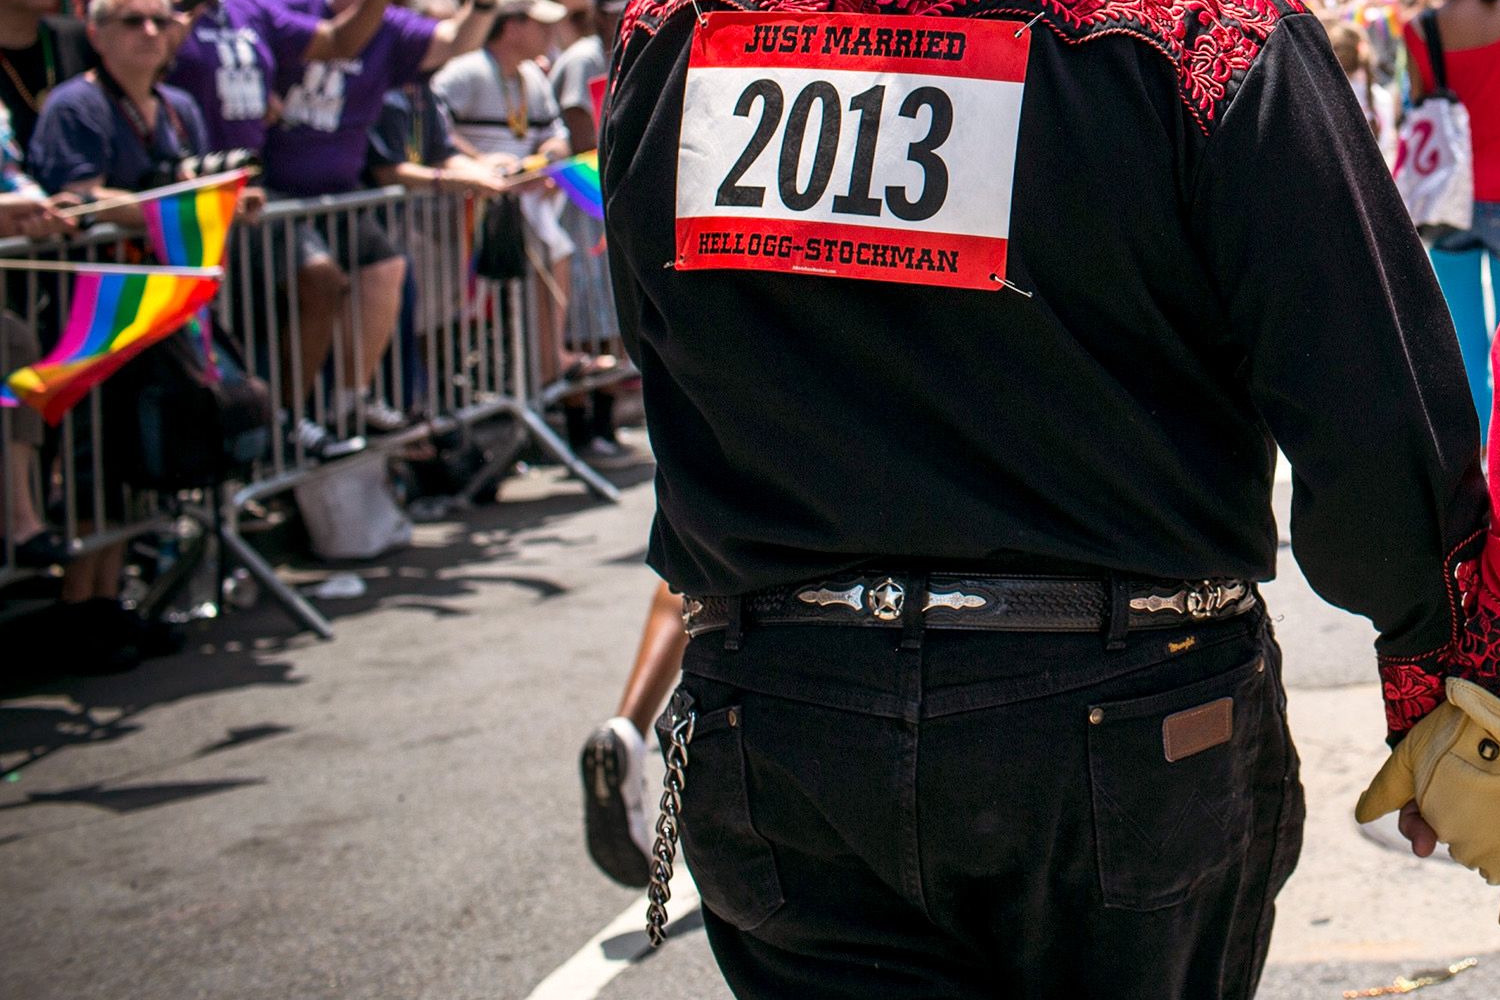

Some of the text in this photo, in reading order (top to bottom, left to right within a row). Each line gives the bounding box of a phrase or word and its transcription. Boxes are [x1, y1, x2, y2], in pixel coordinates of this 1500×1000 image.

[744, 24, 967, 61] JUST MARRIED
[715, 79, 954, 221] 2013
